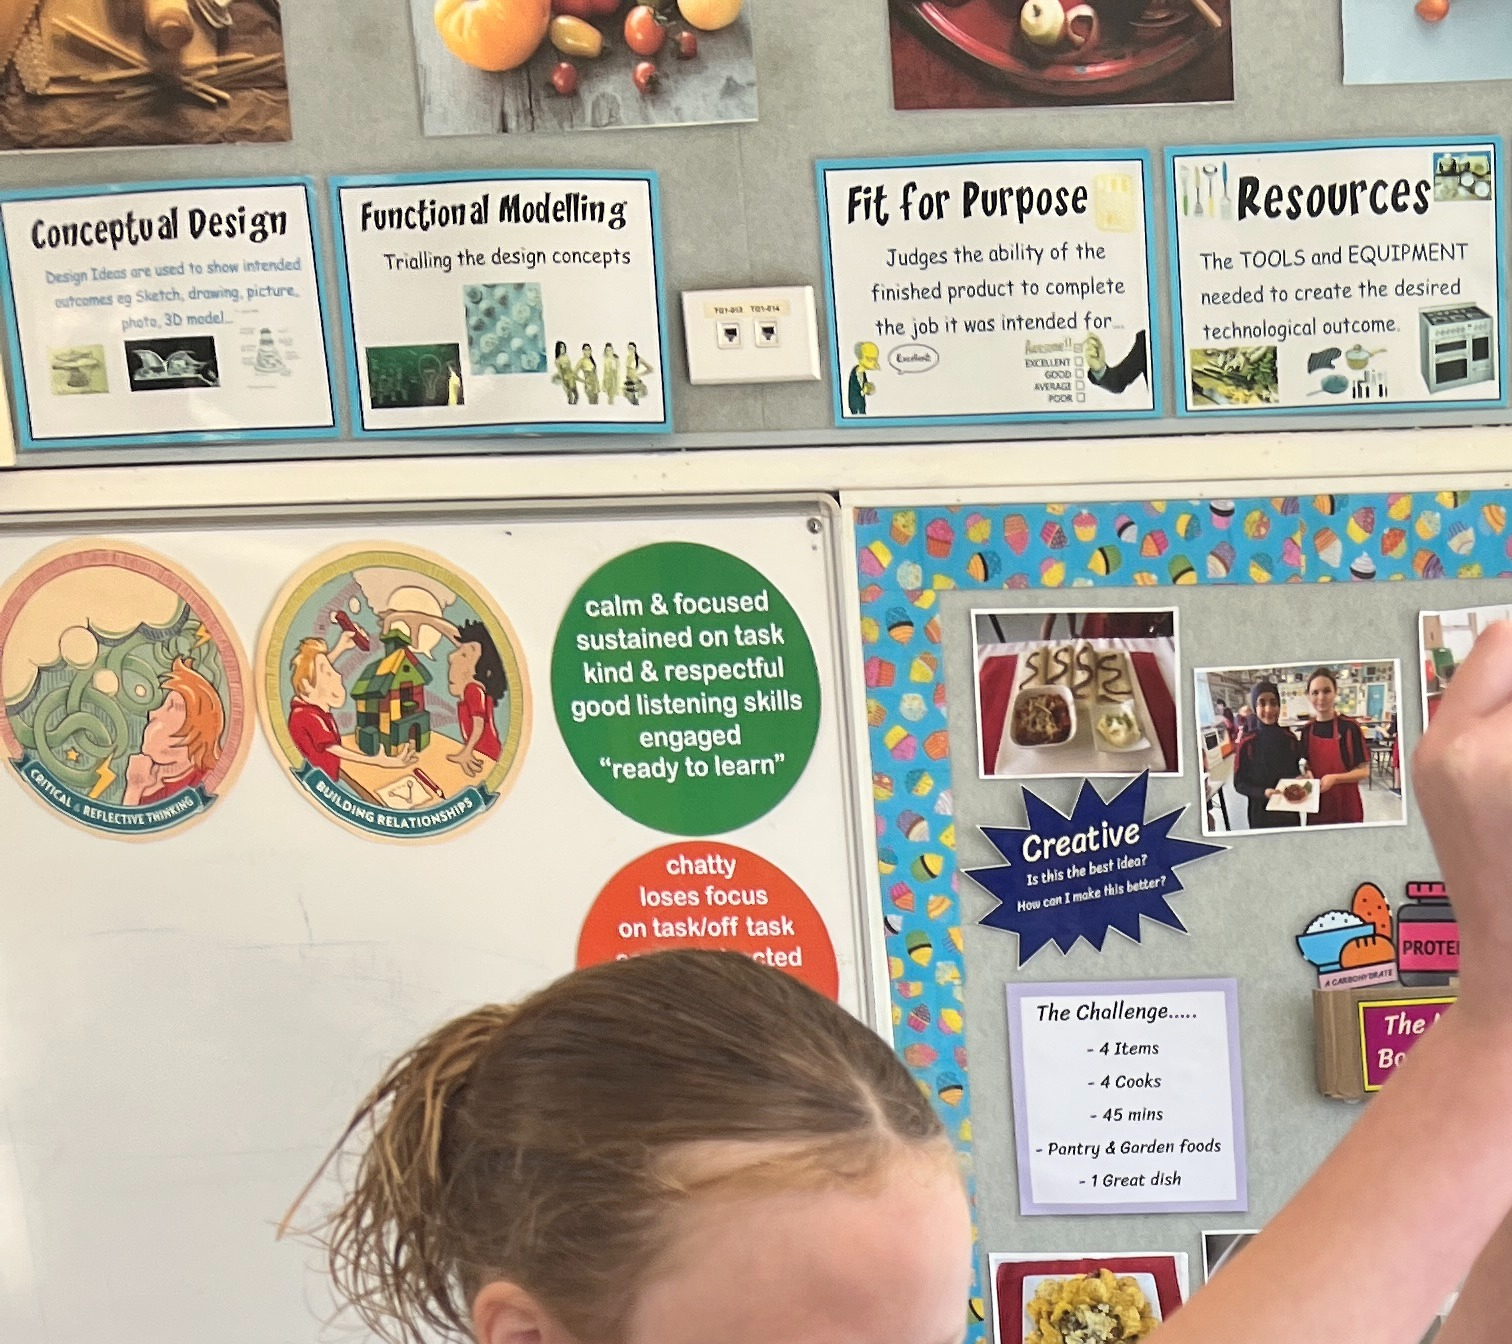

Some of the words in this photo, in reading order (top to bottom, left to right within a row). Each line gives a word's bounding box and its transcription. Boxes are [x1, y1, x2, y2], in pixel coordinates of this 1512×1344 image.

[361, 194, 489, 231] Functional
[500, 192, 628, 229] Modelling
[848, 184, 889, 226] Fit
[900, 181, 950, 221] for
[963, 181, 1088, 224] Purpose
[1238, 175, 1431, 221] Resources
[32, 207, 178, 250] Conceptual
[189, 206, 287, 243] Design
[384, 252, 452, 273] Trialling
[457, 250, 487, 267] the
[491, 248, 545, 270] design
[552, 249, 631, 269] concepts
[886, 248, 948, 270] Judges
[954, 246, 983, 263] the
[989, 243, 1044, 265] ability
[1050, 242, 1069, 260] of
[1076, 242, 1106, 260] the
[1200, 252, 1233, 270] The
[1240, 250, 1305, 269] TOOLS
[1312, 247, 1342, 265] and
[1349, 243, 1468, 266] EQUIPMENT
[45, 269, 88, 287] Design
[91, 268, 126, 281] Ideas
[132, 266, 151, 279] are
[155, 263, 184, 277] used
[189, 263, 202, 274] to
[207, 261, 238, 274] show
[243, 257, 300, 272] intended
[871, 283, 942, 301] finished
[948, 280, 1014, 303] product
[1021, 280, 1039, 295] to
[1046, 277, 1125, 296] complete
[1201, 285, 1264, 306] needed
[1270, 286, 1288, 301] to
[1295, 283, 1352, 301] create
[1359, 280, 1388, 297] the
[1395, 278, 1461, 297] desired
[875, 319, 905, 335] the
[911, 317, 939, 340] job
[946, 316, 958, 333] it
[965, 318, 995, 331] was
[1002, 312, 1077, 330] intended
[1204, 317, 1316, 342] technological
[1323, 317, 1401, 334] outcome.
[586, 594, 643, 618] calm
[650, 593, 669, 616] &
[673, 590, 769, 614] focused
[577, 627, 692, 650] sustained
[700, 629, 728, 648] on
[735, 623, 784, 645] task
[584, 661, 633, 684] kind
[641, 660, 658, 682] &
[665, 656, 784, 685] respectful
[572, 694, 630, 722] good
[636, 692, 738, 718] listening
[744, 690, 802, 712] skills
[640, 724, 742, 752] engaged
[685, 756, 708, 777] to
[31, 769, 72, 807] CRITICAL
[83, 805, 145, 825] REFLECTIVE
[145, 796, 195, 823] THINKING
[316, 781, 374, 822] BUILDING
[378, 797, 473, 829] RELATIONSHIPS
[1022, 820, 1141, 862] Creative
[666, 854, 736, 879] chatty
[1026, 874, 1038, 886] Is
[1041, 870, 1064, 884] this
[1067, 866, 1086, 880] the
[1090, 861, 1114, 876] best
[1117, 854, 1148, 870] idea?
[640, 886, 700, 907] loses
[705, 885, 768, 906] focus
[1017, 900, 1041, 912] How
[1043, 895, 1062, 907] can
[1065, 893, 1071, 904] I
[1073, 889, 1101, 902] make
[1104, 884, 1124, 897] this
[1127, 875, 1167, 893] better?
[618, 922, 646, 938] on
[653, 917, 739, 938] task/off
[747, 916, 794, 936] task
[1403, 940, 1460, 956] PROTEI
[1332, 969, 1393, 985] CARBOHYDRATE
[1037, 1003, 1070, 1022] The
[1385, 1012, 1426, 1035] The
[1100, 1042, 1110, 1055] 4
[1115, 1042, 1160, 1055] Items
[1101, 1075, 1110, 1088] 4
[1115, 1073, 1162, 1088] Cooks
[1103, 1108, 1123, 1122] 45
[1128, 1107, 1163, 1121] mins
[1048, 1142, 1100, 1159] Pantry
[1106, 1141, 1116, 1154] &
[1120, 1139, 1174, 1154] Garden
[1179, 1139, 1222, 1154] foods
[1091, 1175, 1098, 1187] 1
[1103, 1174, 1145, 1187] Great
[1150, 1171, 1182, 1186] dish
